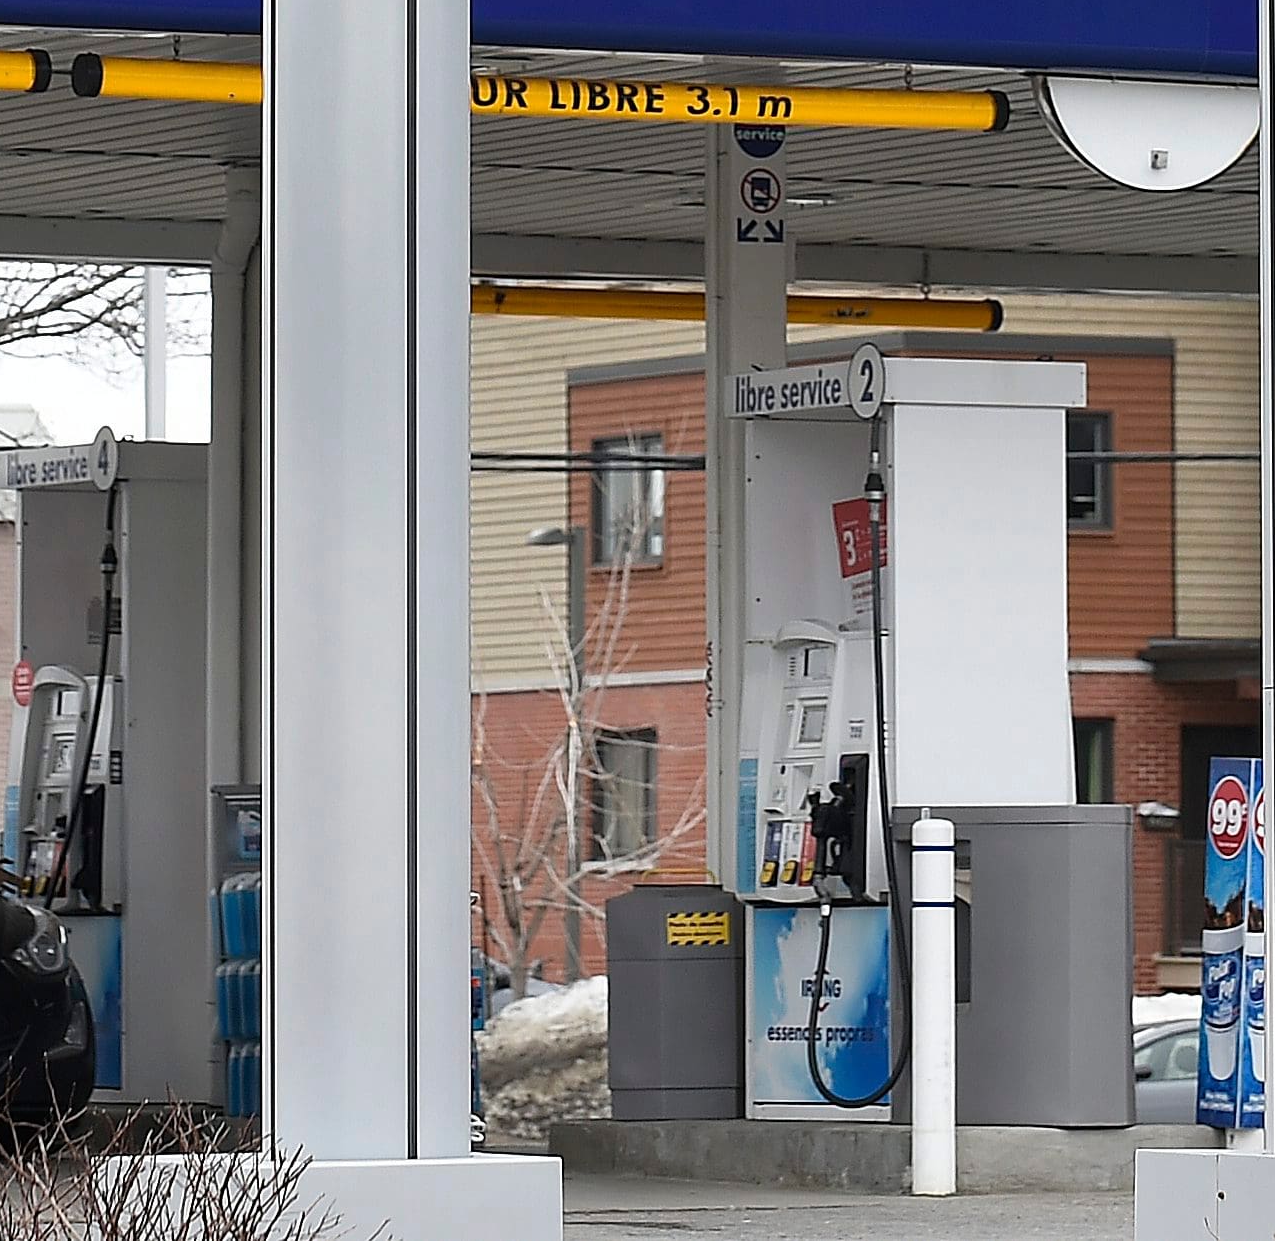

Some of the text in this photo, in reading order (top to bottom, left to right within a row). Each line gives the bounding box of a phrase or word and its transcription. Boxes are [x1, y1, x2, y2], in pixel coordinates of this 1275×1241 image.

[549, 78, 664, 114] LIBRE
[686, 85, 739, 117] 3.1
[756, 94, 793, 119] m
[735, 127, 785, 142] service
[735, 369, 842, 413] libre service
[859, 359, 874, 403] 2
[42, 448, 88, 482] service
[97, 440, 109, 476] 4
[801, 979, 842, 998] IRNG
[767, 1026, 822, 1041] essencs
